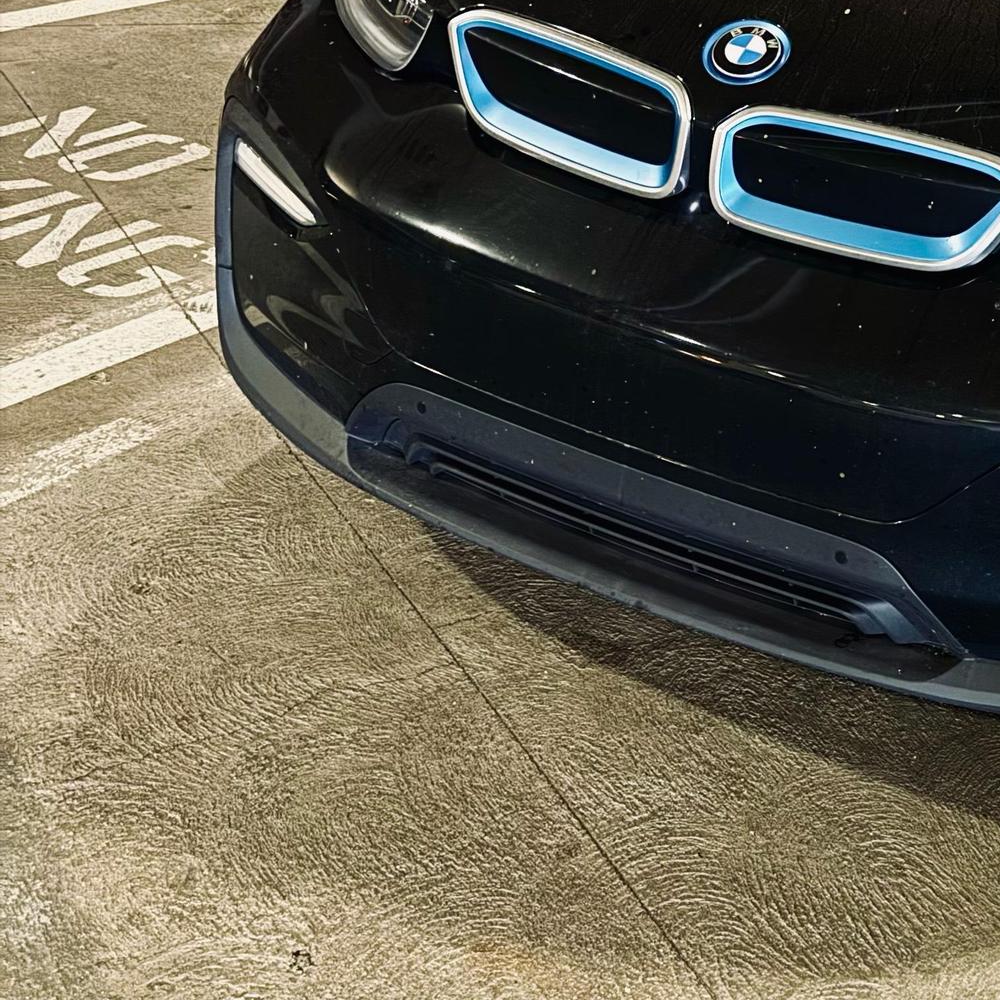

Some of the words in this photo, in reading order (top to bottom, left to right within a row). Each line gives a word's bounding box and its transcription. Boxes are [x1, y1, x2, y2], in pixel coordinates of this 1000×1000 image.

[730, 28, 778, 48] BMW
[0, 105, 211, 182] NO
[0, 178, 216, 298] ING
